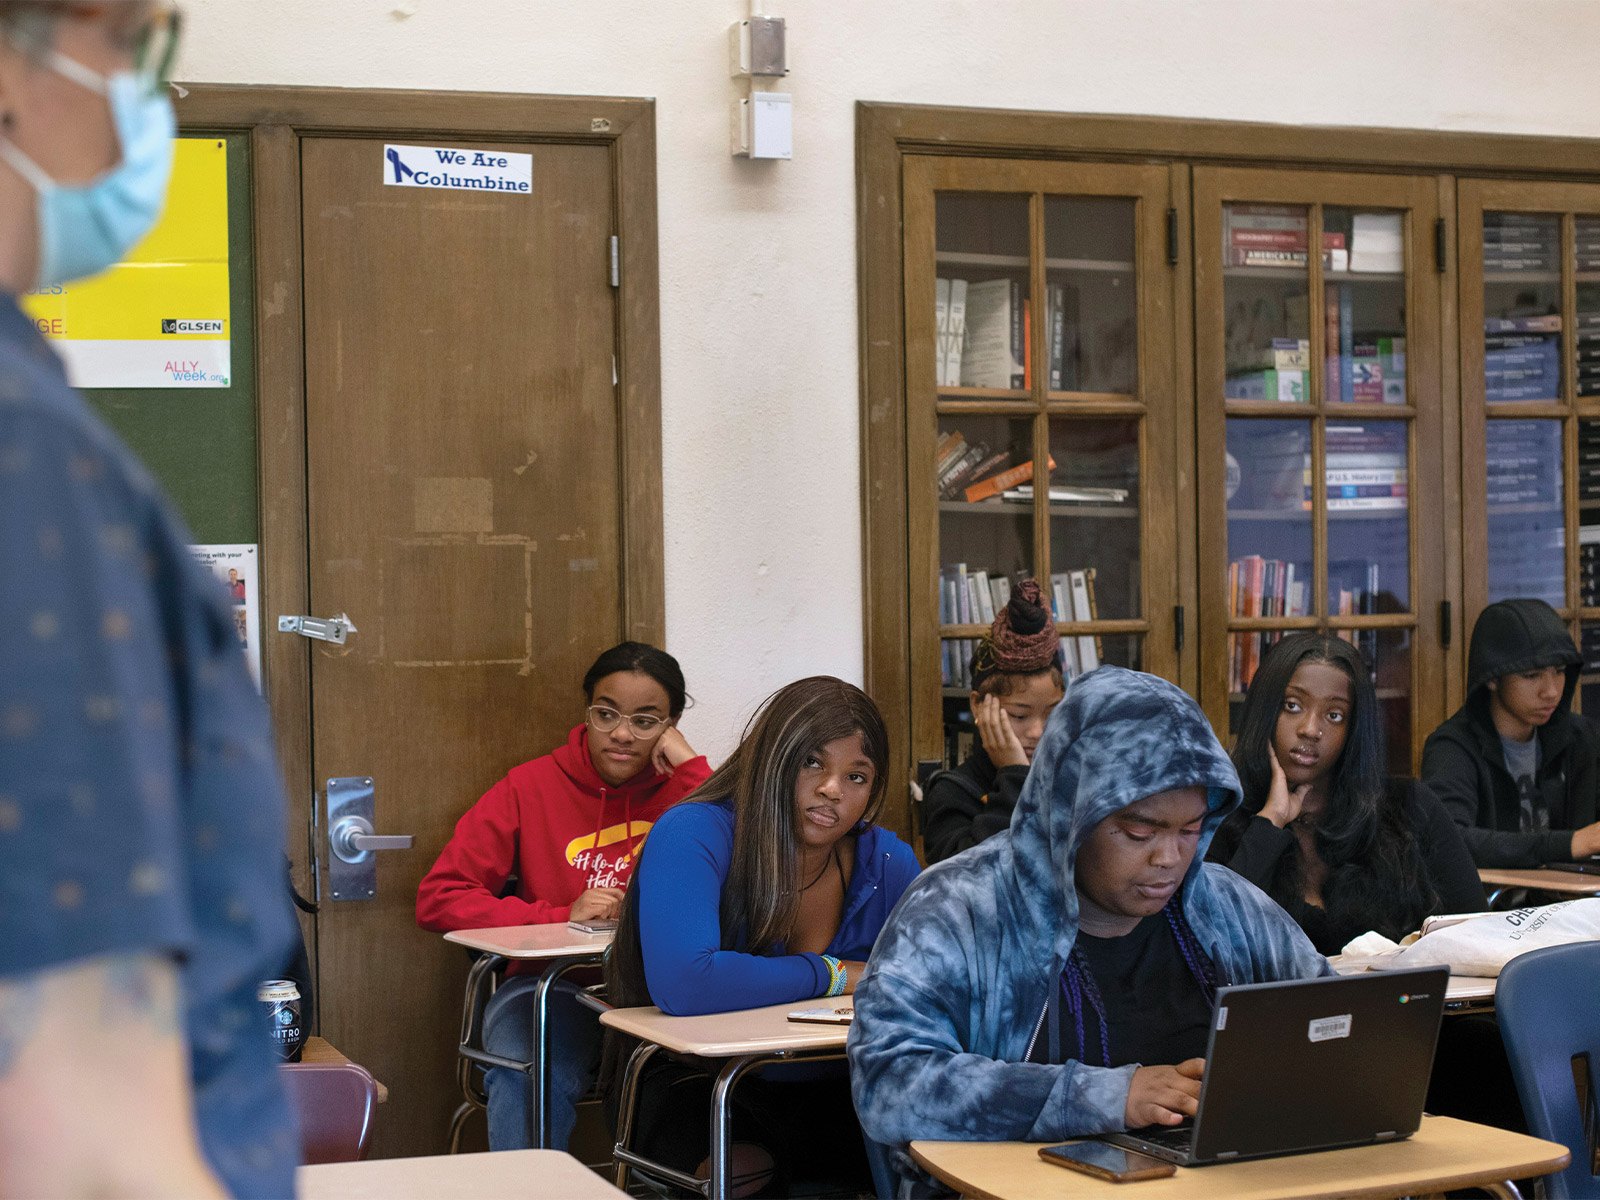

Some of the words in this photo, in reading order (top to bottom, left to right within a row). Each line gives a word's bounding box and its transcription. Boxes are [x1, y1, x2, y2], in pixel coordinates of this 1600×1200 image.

[435, 150, 466, 165] We
[471, 152, 508, 168] Are
[413, 171, 529, 191] Columbine
[177, 322, 221, 331] GLSEN
[164, 361, 199, 372] ALLY
[173, 370, 207, 381] week
[1506, 907, 1537, 926] CHE
